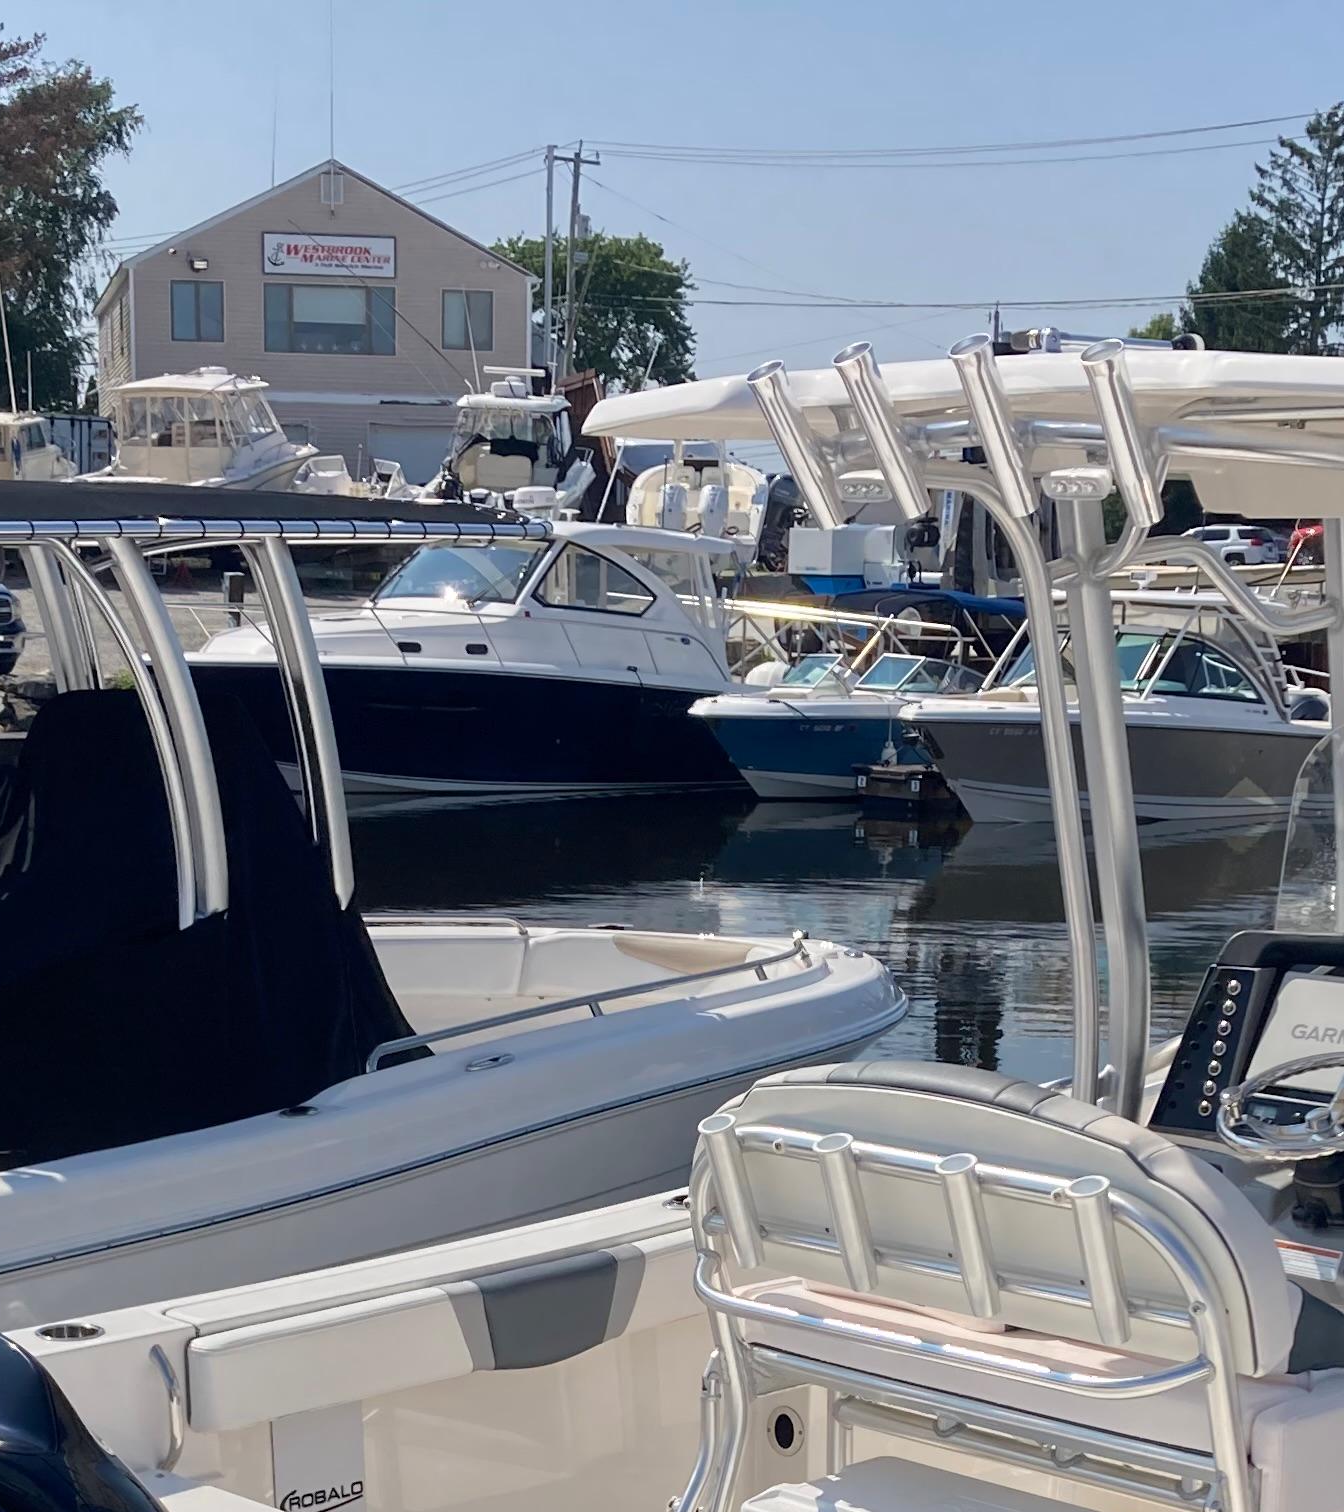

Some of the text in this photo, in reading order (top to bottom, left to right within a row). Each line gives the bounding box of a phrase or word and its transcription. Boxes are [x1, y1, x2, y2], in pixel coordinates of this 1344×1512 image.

[285, 243, 372, 256] WESTBROOK
[300, 253, 391, 265] MARINE CENTER
[288, 1480, 364, 1512] ROBALO
